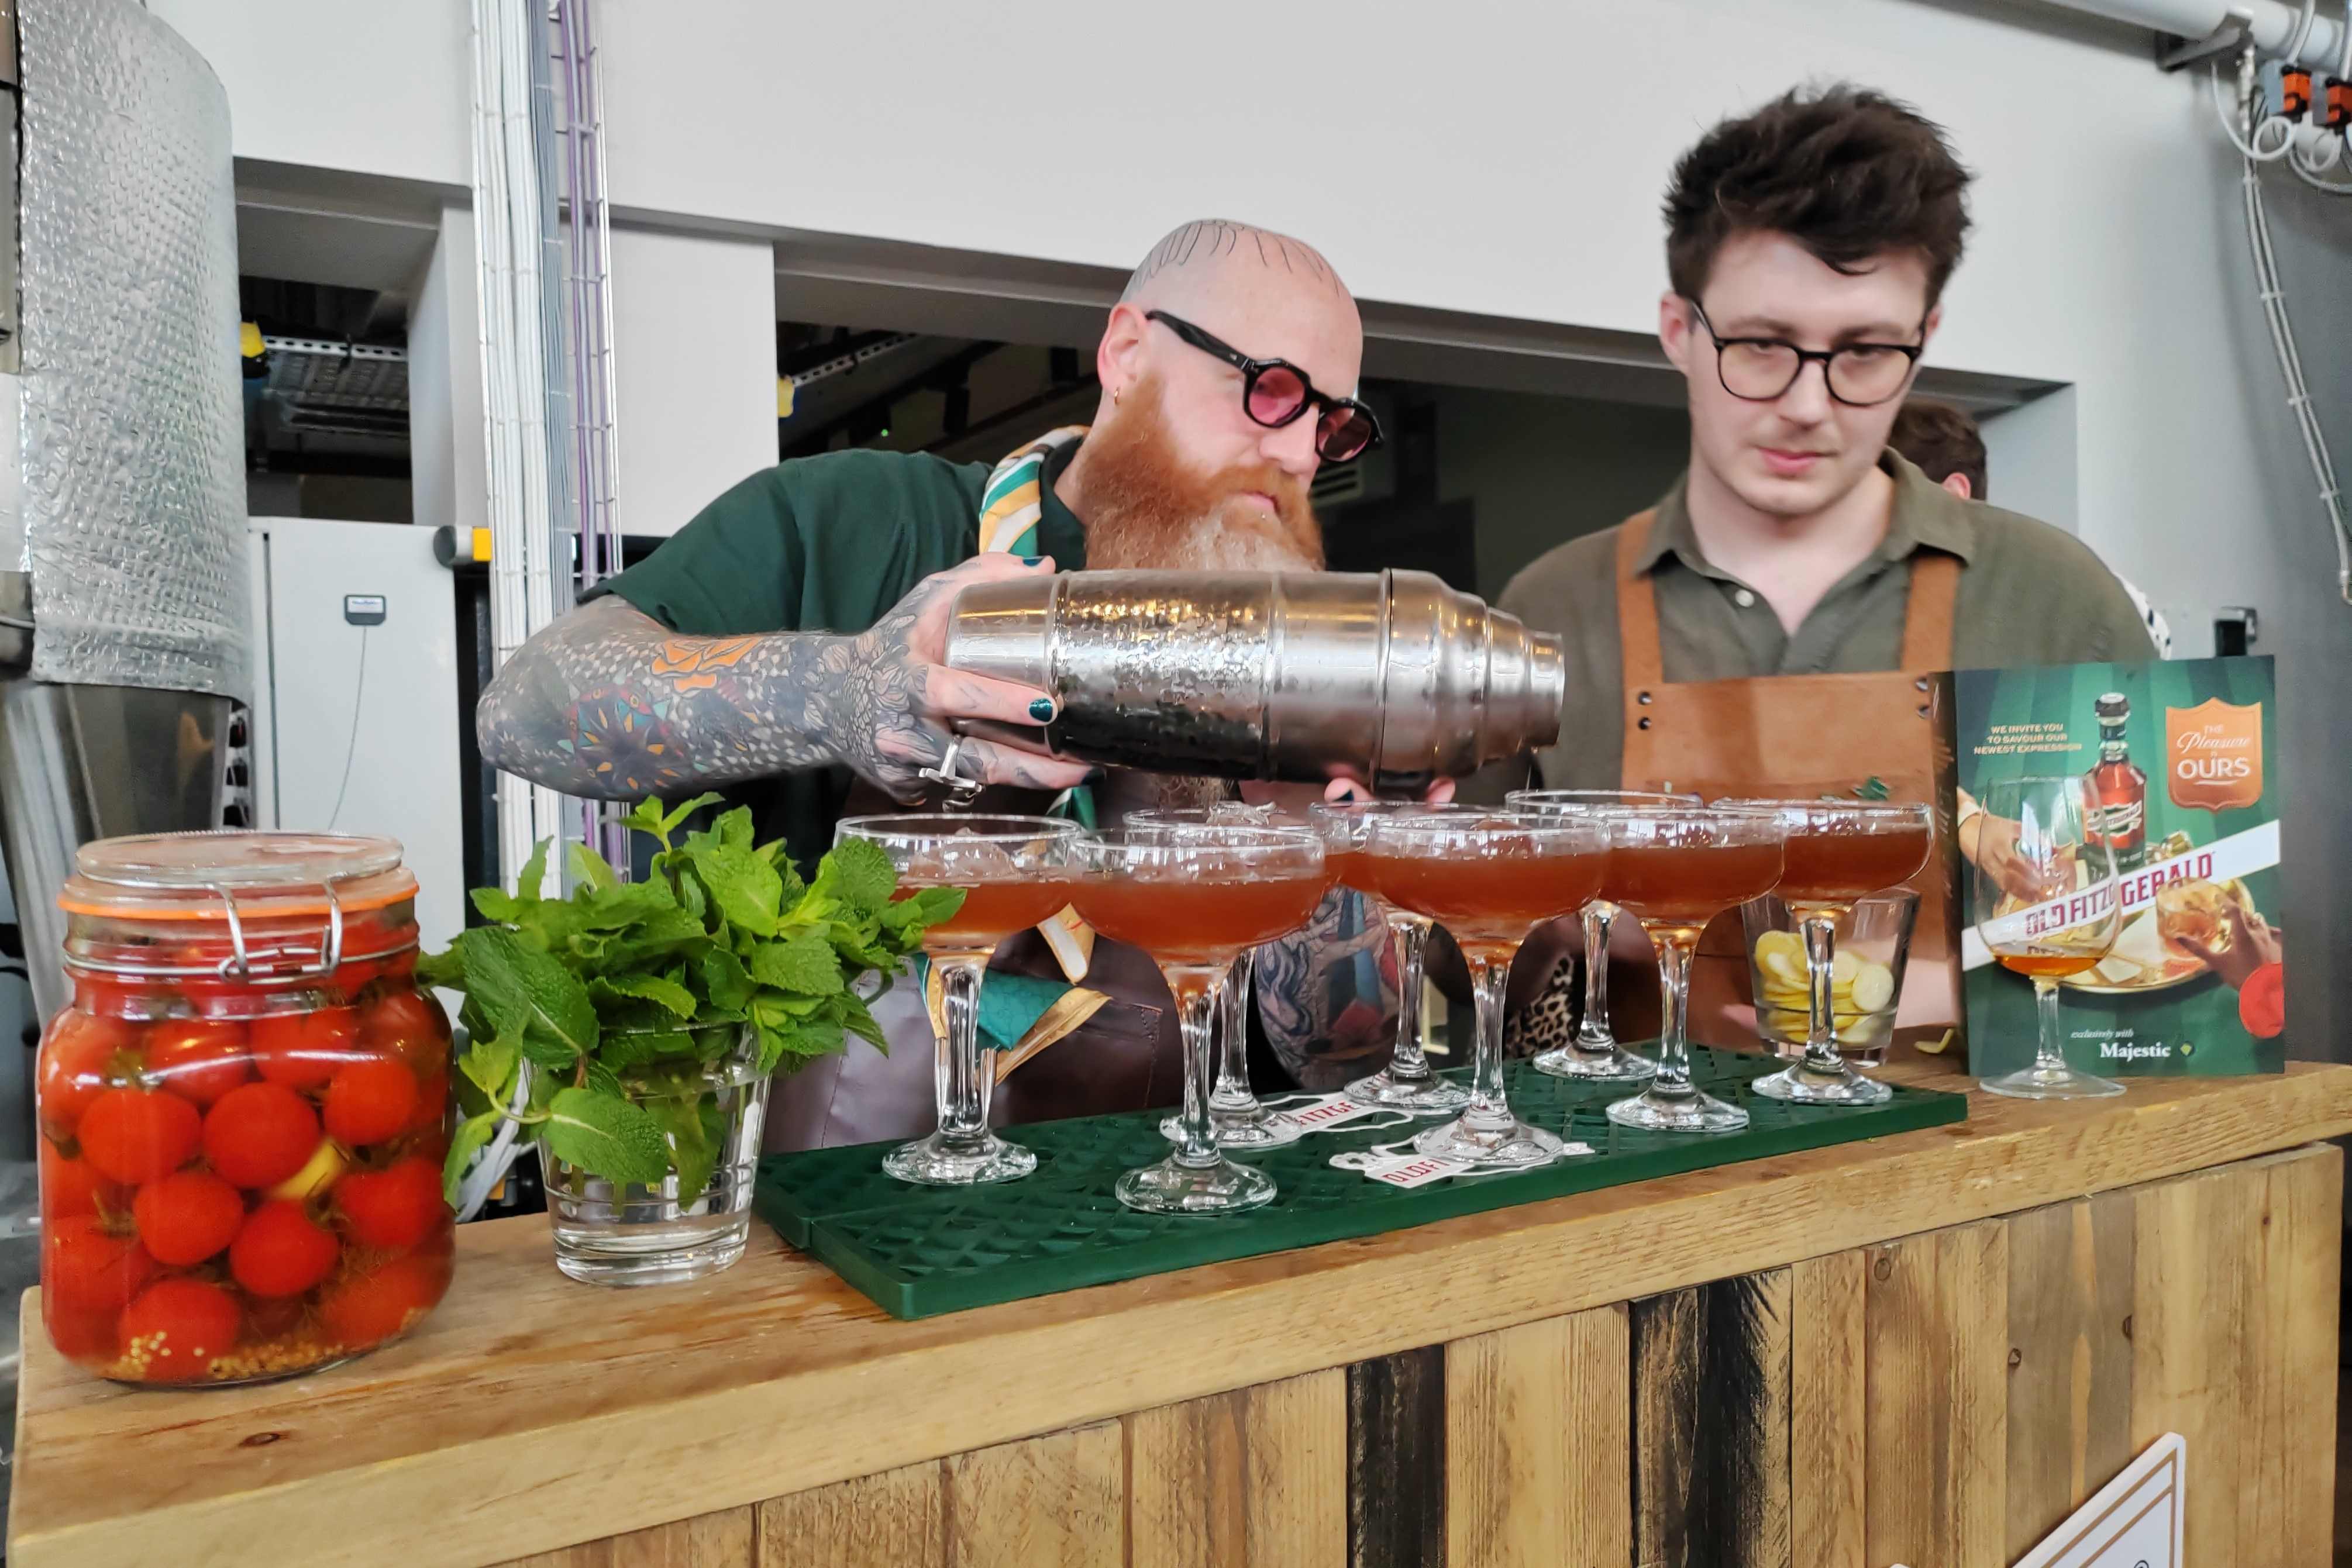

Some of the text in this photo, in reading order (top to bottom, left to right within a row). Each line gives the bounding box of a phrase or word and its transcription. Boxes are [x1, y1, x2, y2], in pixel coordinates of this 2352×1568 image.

[1991, 723, 2063, 733] WE INVITE YOU
[1987, 733, 2068, 744] TO SAVOUR OUR
[1974, 745, 2015, 754] NEWEST
[2177, 757, 2250, 779] OURS
[2115, 1028, 2134, 1038] with
[2099, 1041, 2171, 1062] Majestic
